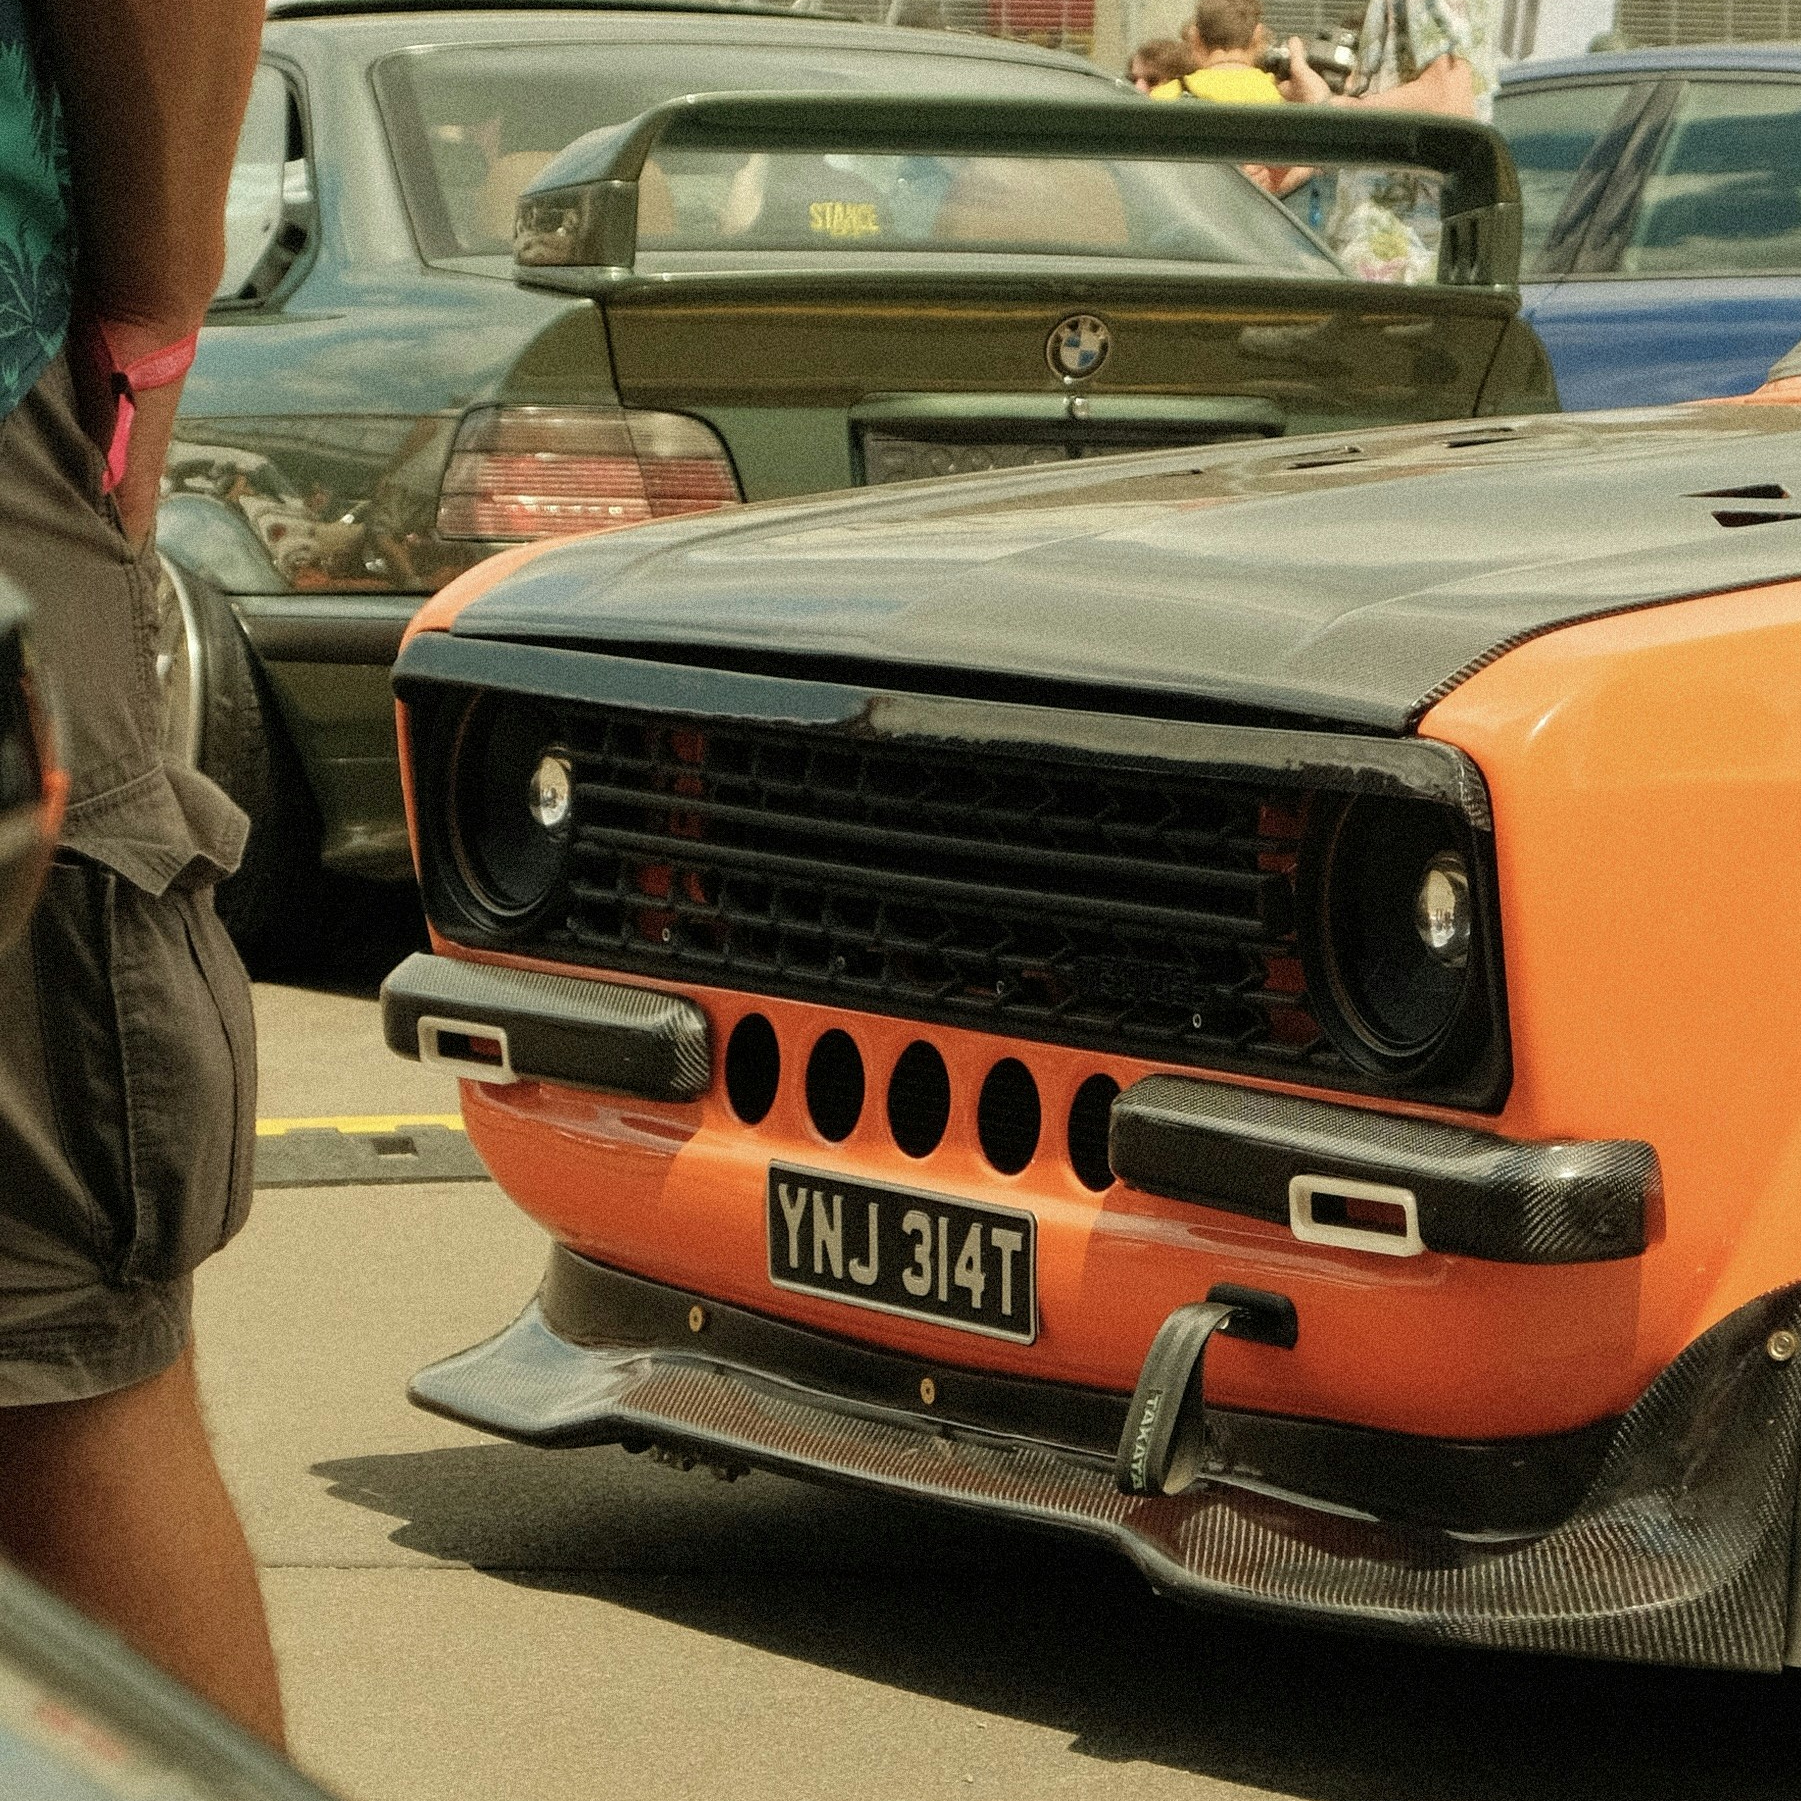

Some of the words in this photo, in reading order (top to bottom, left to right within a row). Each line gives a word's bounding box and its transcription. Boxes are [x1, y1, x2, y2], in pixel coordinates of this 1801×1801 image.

[778, 1183, 879, 1286] YNJ
[902, 1210, 1022, 1316] 314T
[1130, 1395, 1160, 1490] TAKATA
